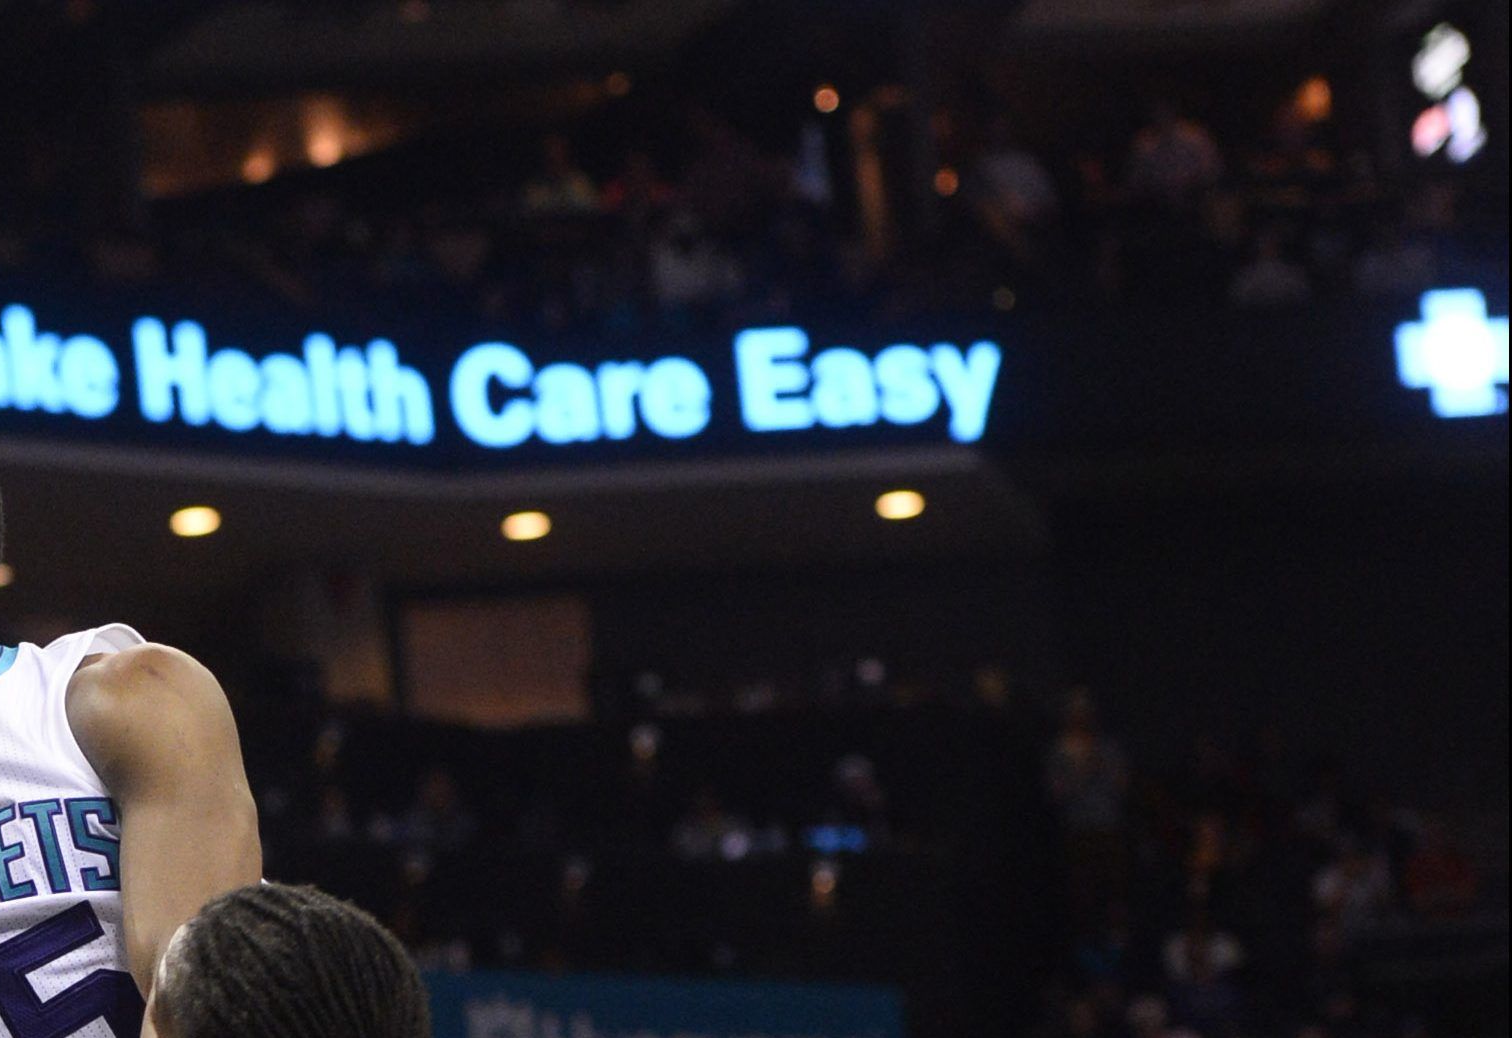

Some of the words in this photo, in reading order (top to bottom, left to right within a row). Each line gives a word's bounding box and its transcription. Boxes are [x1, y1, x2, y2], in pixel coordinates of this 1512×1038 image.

[131, 316, 435, 445] Health
[449, 342, 712, 448] Care
[734, 326, 1002, 443] Easy
